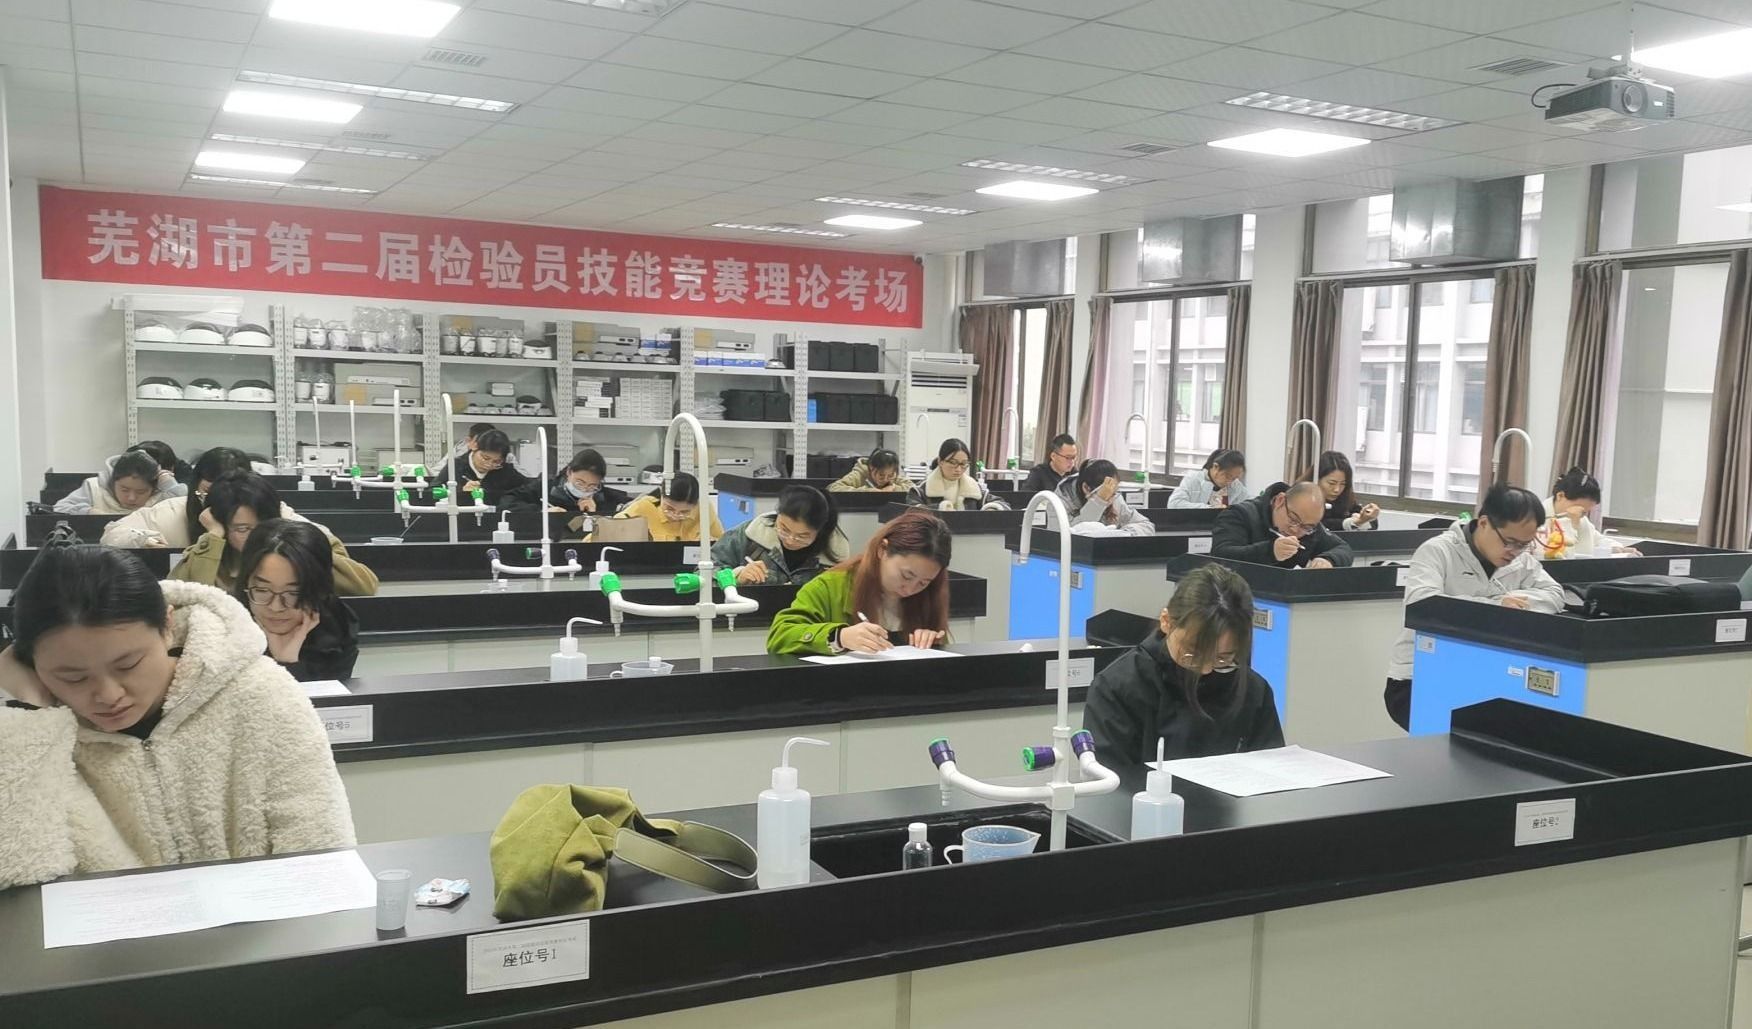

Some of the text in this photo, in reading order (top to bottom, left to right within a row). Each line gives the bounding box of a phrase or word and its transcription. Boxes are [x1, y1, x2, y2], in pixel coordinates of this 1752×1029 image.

[87, 208, 908, 313] 芜湖市第二届检验员技能竞赛理论考场
[502, 947, 557, 968] 座位号1
